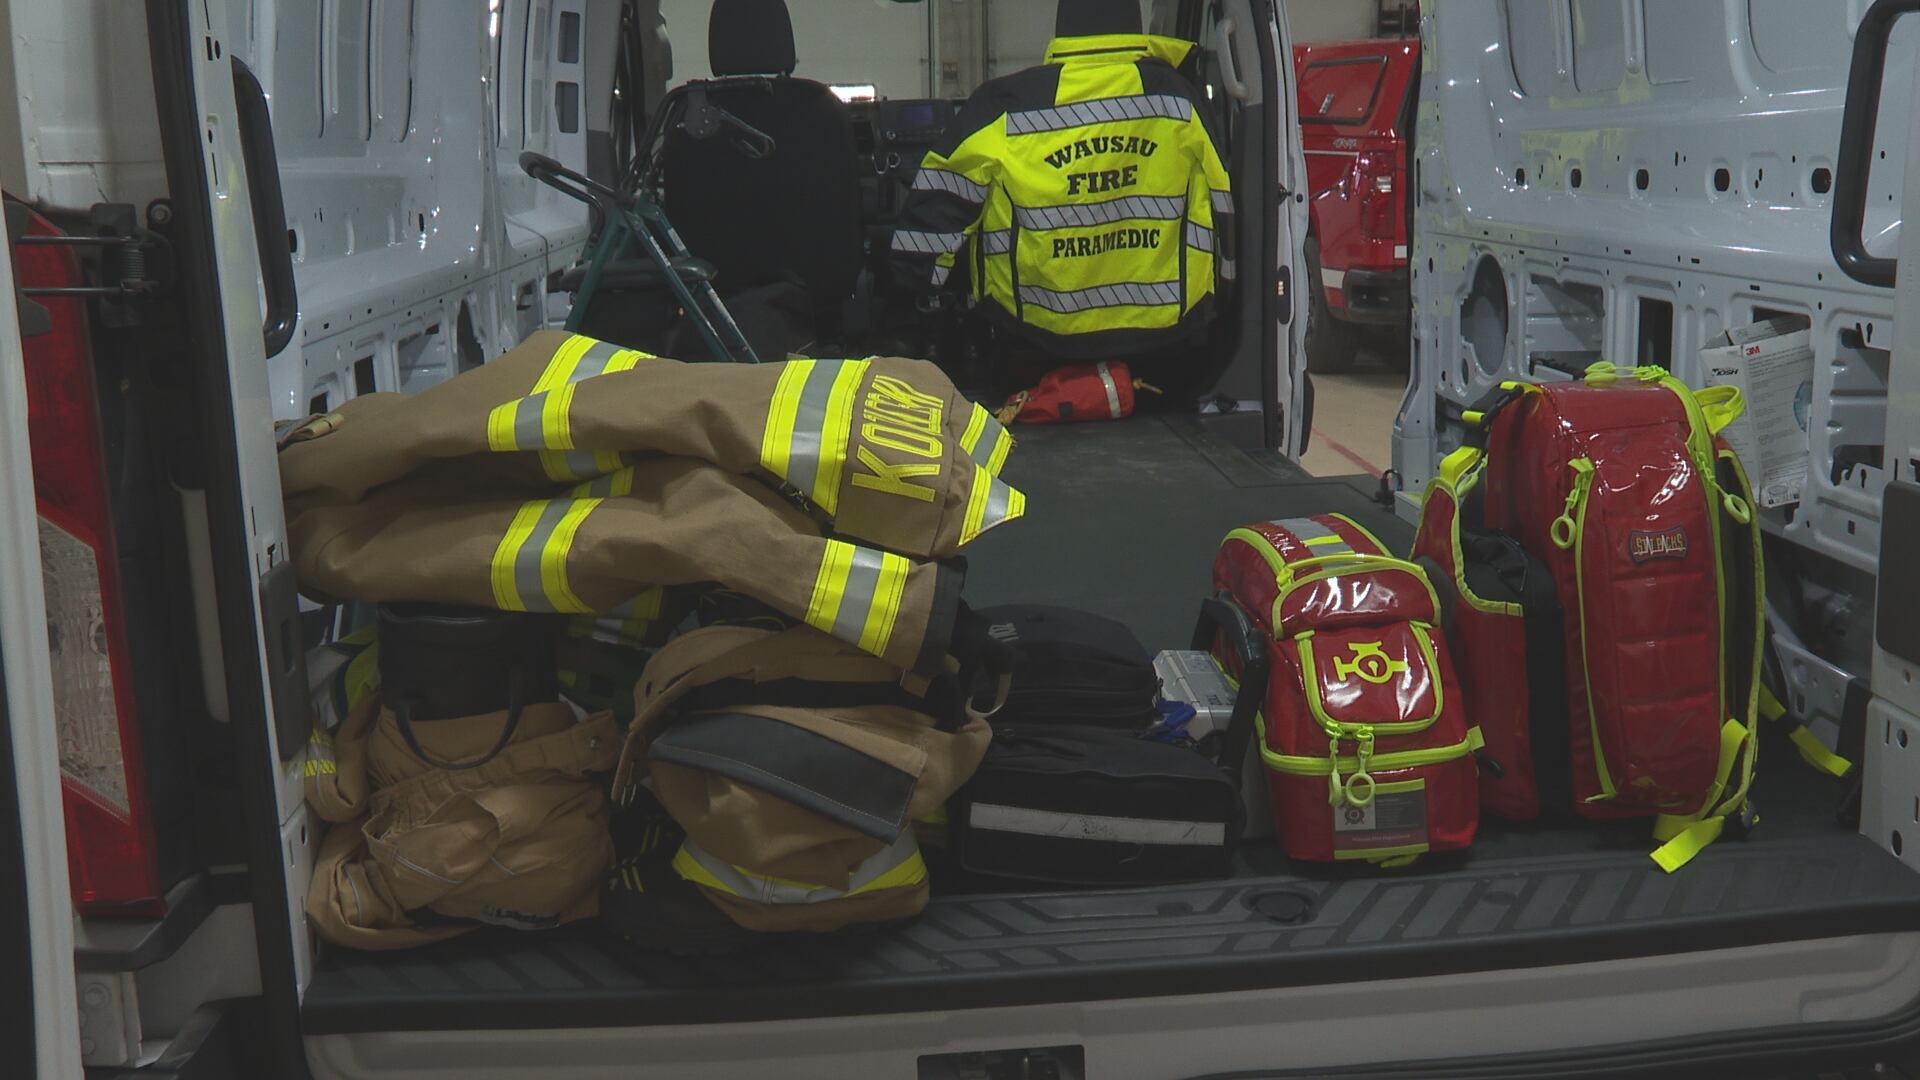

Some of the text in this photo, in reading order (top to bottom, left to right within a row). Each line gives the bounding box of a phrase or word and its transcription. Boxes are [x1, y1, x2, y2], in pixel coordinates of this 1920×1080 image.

[1044, 135, 1158, 169] WAUSAU
[1067, 164, 1138, 195] FIRE
[1052, 228, 1160, 258] PARAMEDIC
[1745, 345, 1760, 356] 3M
